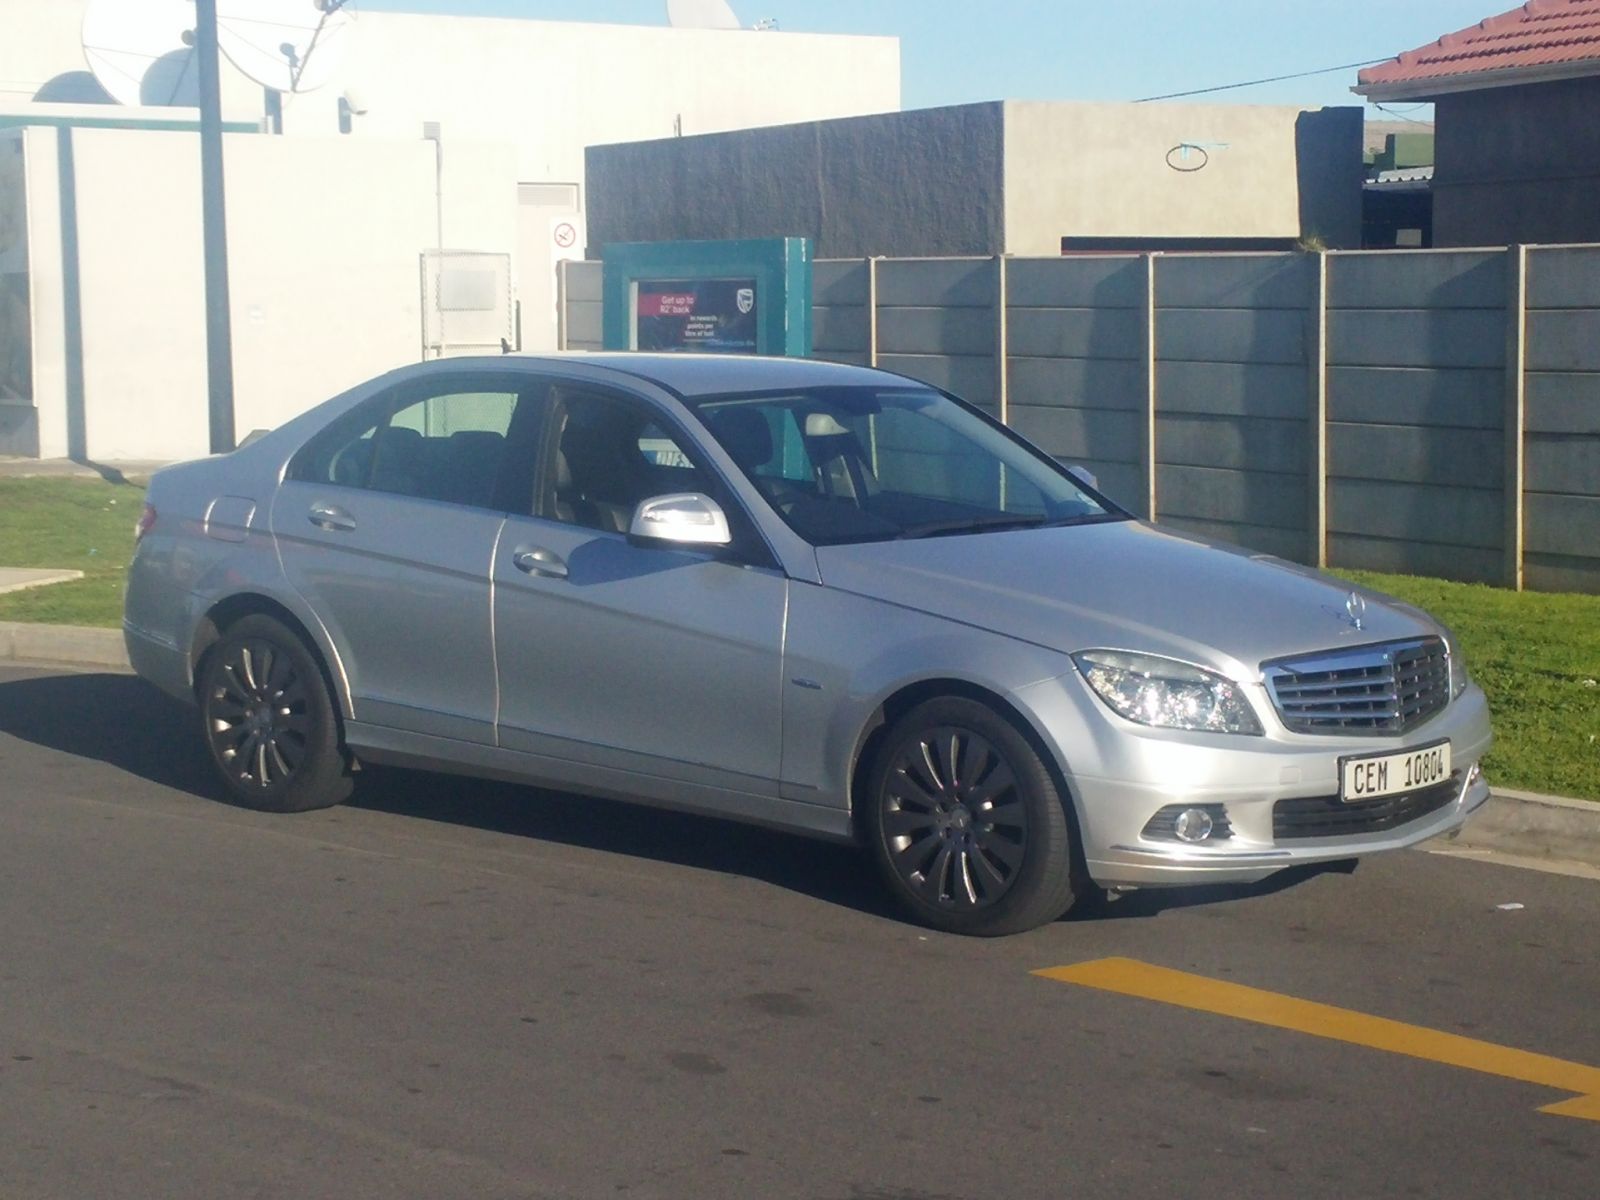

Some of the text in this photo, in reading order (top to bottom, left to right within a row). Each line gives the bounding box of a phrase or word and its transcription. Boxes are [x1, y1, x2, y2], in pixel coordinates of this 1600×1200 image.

[661, 295, 695, 306] Get up to
[673, 305, 691, 314] back
[1354, 749, 1443, 794] CEM 10804
